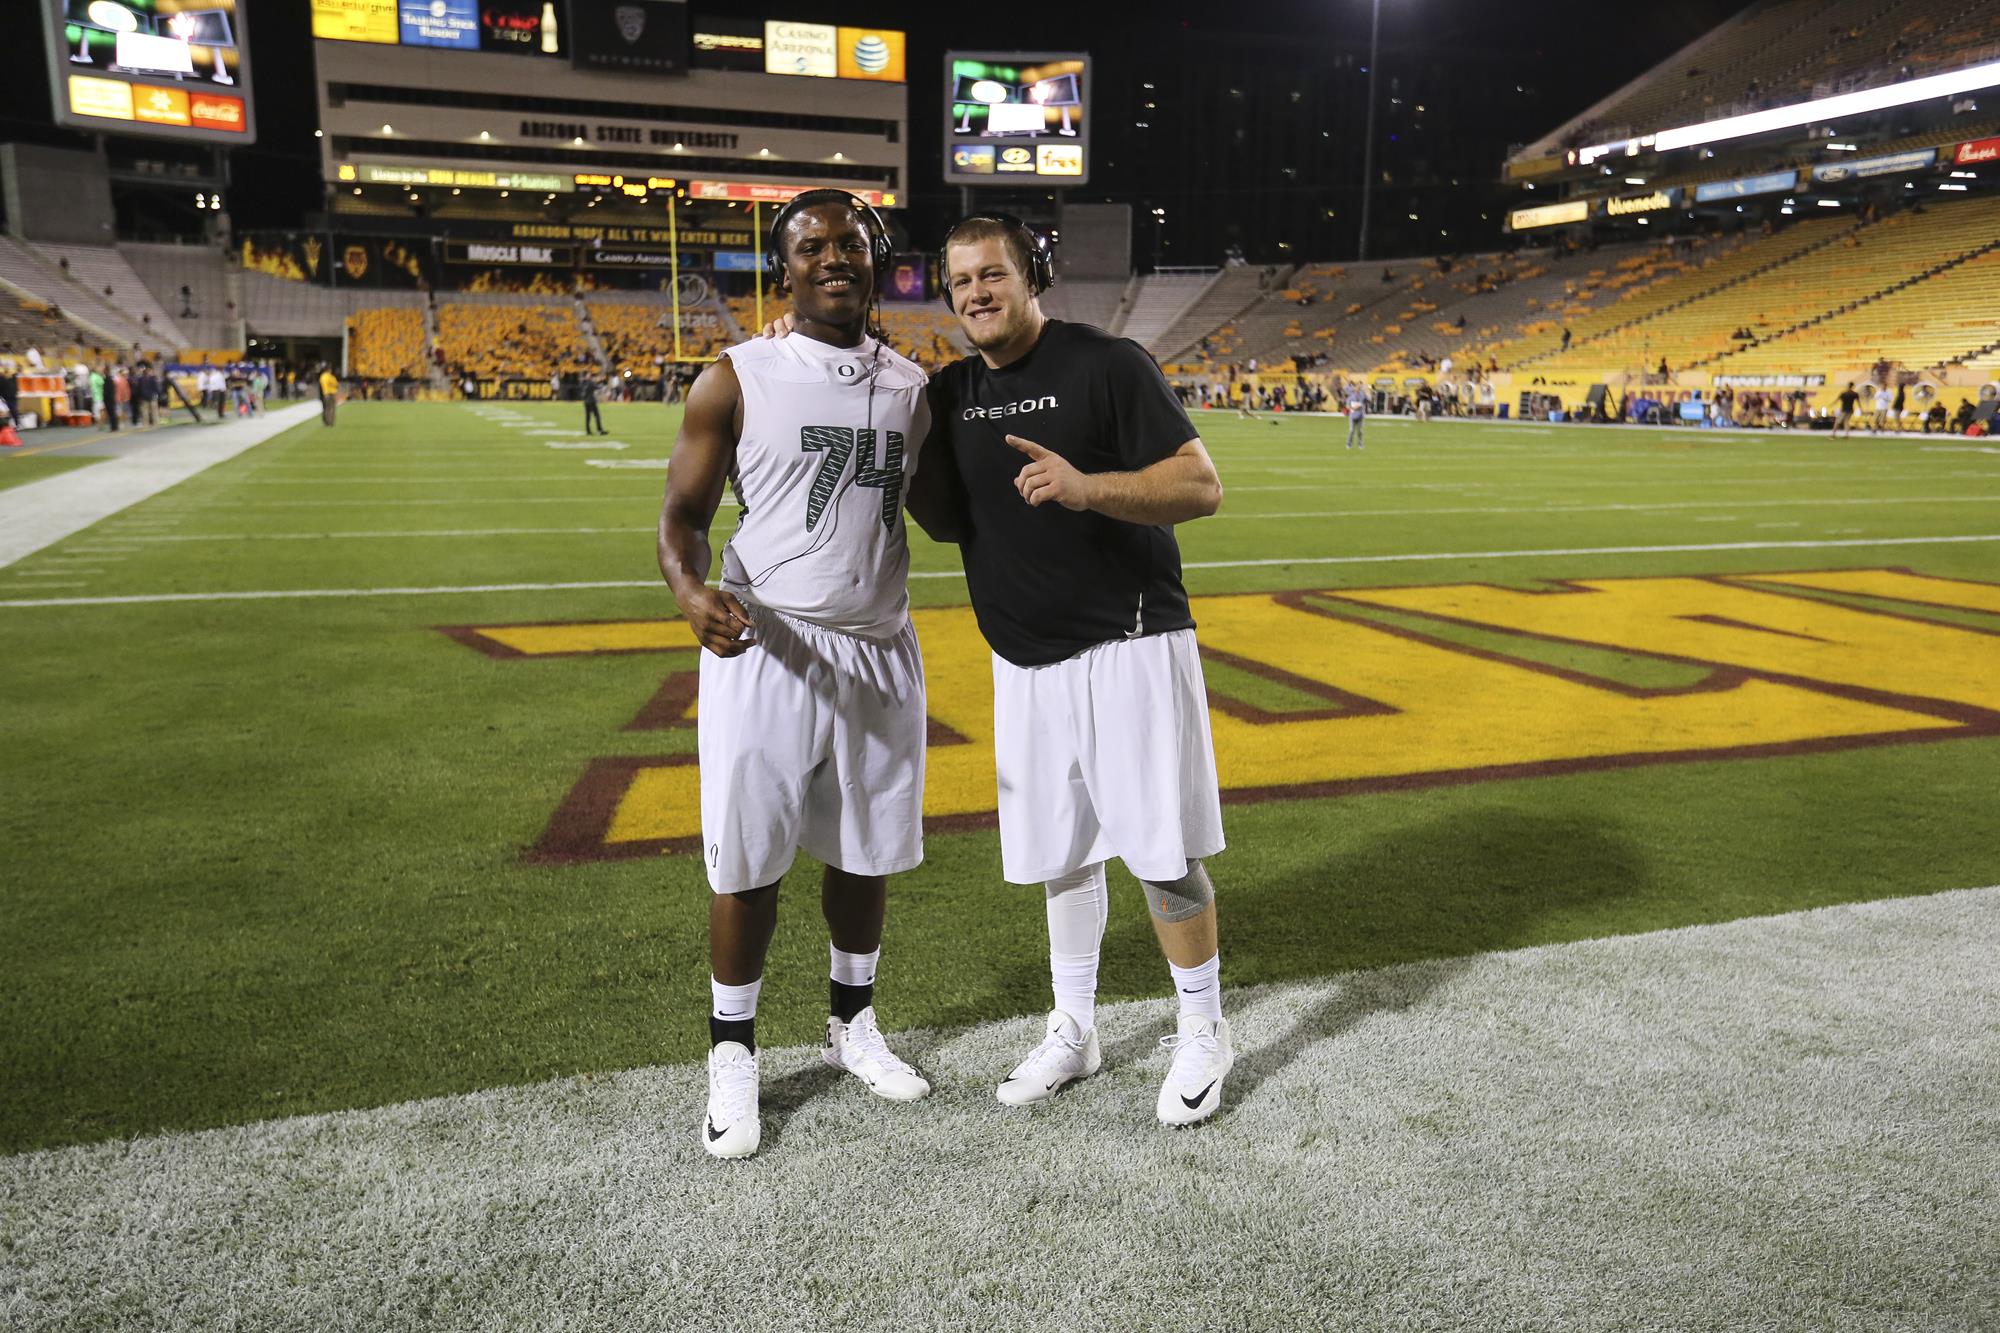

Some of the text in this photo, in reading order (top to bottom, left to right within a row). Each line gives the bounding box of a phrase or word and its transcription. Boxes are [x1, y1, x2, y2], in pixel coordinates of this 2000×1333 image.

[519, 120, 739, 150] ARIZONA STATE UNIVERSITY
[512, 223, 570, 238] ABANDON
[574, 228, 604, 240] HOPE
[608, 229, 629, 242] ALL
[632, 229, 647, 243] YE
[680, 232, 717, 245] ENTER
[719, 233, 750, 246] HERE
[467, 244, 553, 263] MUSCLE MILK
[800, 425, 906, 537] 74
